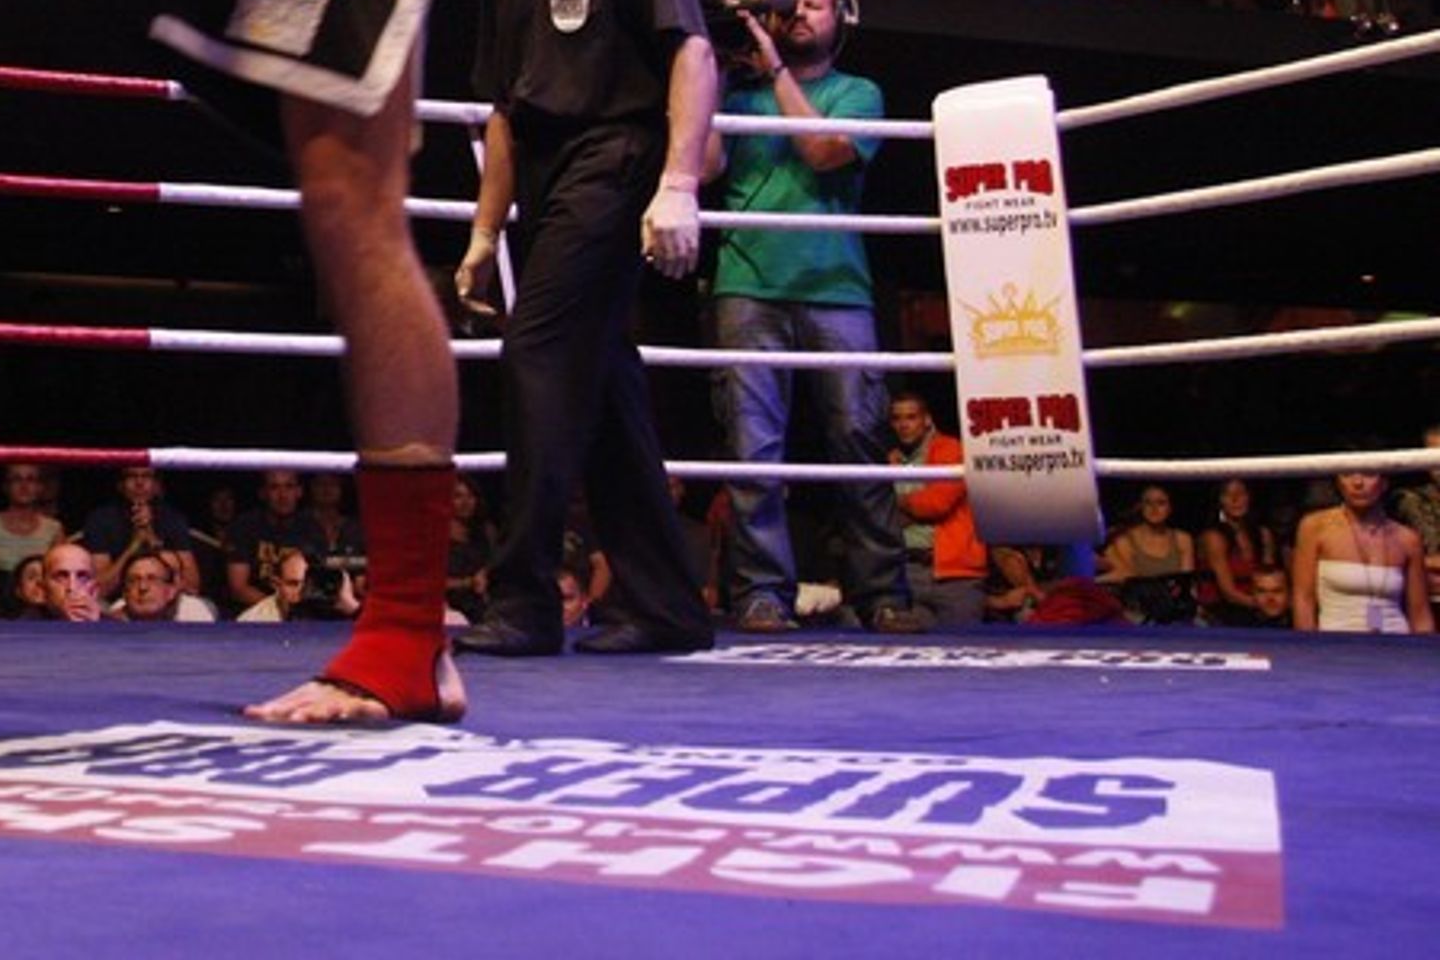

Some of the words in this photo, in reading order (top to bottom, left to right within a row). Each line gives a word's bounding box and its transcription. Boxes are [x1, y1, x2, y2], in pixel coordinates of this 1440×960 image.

[945, 162, 1008, 202] SUPER
[1012, 158, 1054, 195] PRO
[965, 199, 1000, 209] FIGHT
[1003, 196, 1036, 207] WEAR
[949, 208, 1058, 236] www.superpro.tv
[967, 396, 1033, 438] SUPER
[1037, 393, 1081, 433] PRO
[989, 436, 1025, 447] FIGHT
[1028, 434, 1062, 446] WEAR
[972, 447, 1085, 476] www.superpro.tv
[424, 751, 1181, 831] SUPER
[303, 828, 1222, 916] FIGHT
